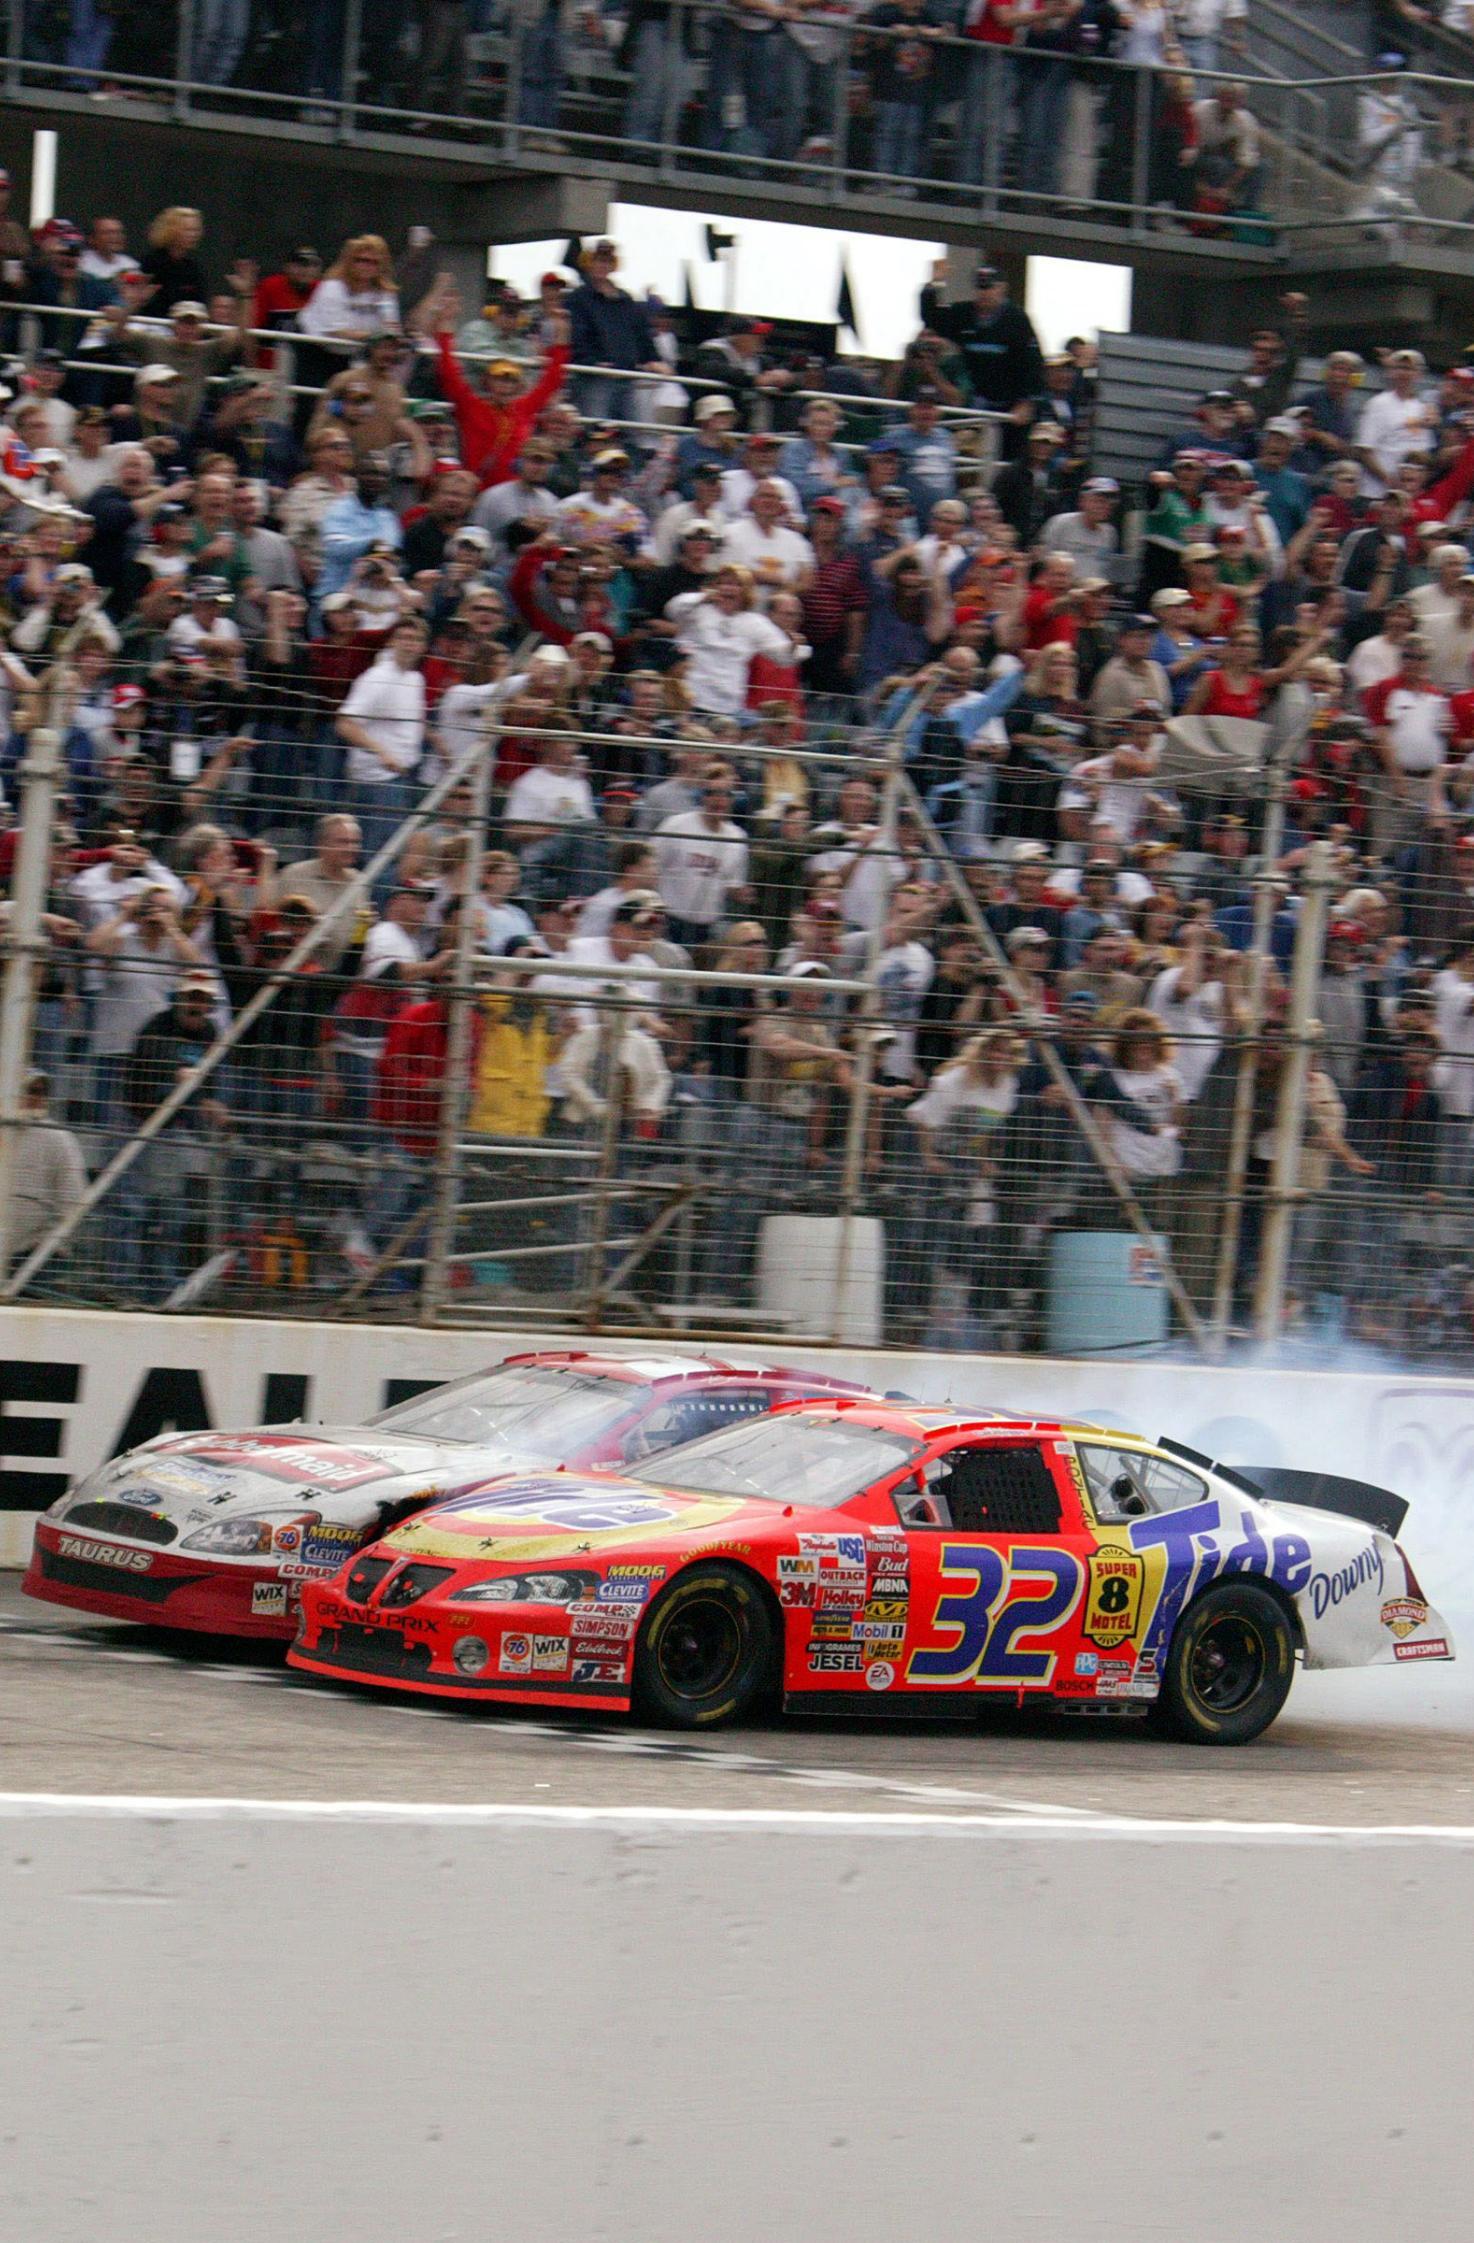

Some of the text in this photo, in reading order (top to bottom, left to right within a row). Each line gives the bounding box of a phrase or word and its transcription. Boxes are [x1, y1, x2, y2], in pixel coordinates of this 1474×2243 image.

[279, 1531, 297, 1545] 76
[308, 1525, 363, 1542] MOOG
[59, 1536, 153, 1571] TAURUS
[680, 1540, 751, 1563] GOODYEAR
[838, 1537, 864, 1563] USG
[282, 1563, 333, 1577] COMP
[608, 1566, 666, 1577] MOOG
[780, 1560, 814, 1573] WM
[878, 1557, 909, 1571] Bud
[1096, 1562, 1137, 1578] SUPER
[820, 1571, 864, 1580] OUTBACK
[1129, 1499, 1312, 1650] Tide
[1309, 1541, 1384, 1619] Downy
[254, 1585, 284, 1601] WIX
[600, 1583, 645, 1597] CLEVITE
[873, 1579, 908, 1592] MBNA
[781, 1582, 816, 1606] 3M
[822, 1589, 864, 1609] Holley
[1097, 1577, 1130, 1613] 8
[569, 1604, 623, 1614] COMP
[905, 1543, 1084, 1686] 32
[1381, 1605, 1425, 1620] DIAMOND
[316, 1602, 381, 1625] GRAND
[386, 1613, 442, 1633] PRIX
[1090, 1612, 1132, 1630] MOTEL
[574, 1619, 628, 1637] SIMPSON
[853, 1624, 888, 1638] Mobil
[508, 1640, 526, 1654] 76
[535, 1638, 566, 1654] WIX
[877, 1643, 898, 1651] Auto
[809, 1655, 864, 1670] JESEL
[1077, 1652, 1097, 1671] PPG
[573, 1662, 623, 1682] JE
[870, 1665, 890, 1679] EA
[1055, 1680, 1095, 1692] BOSCH
